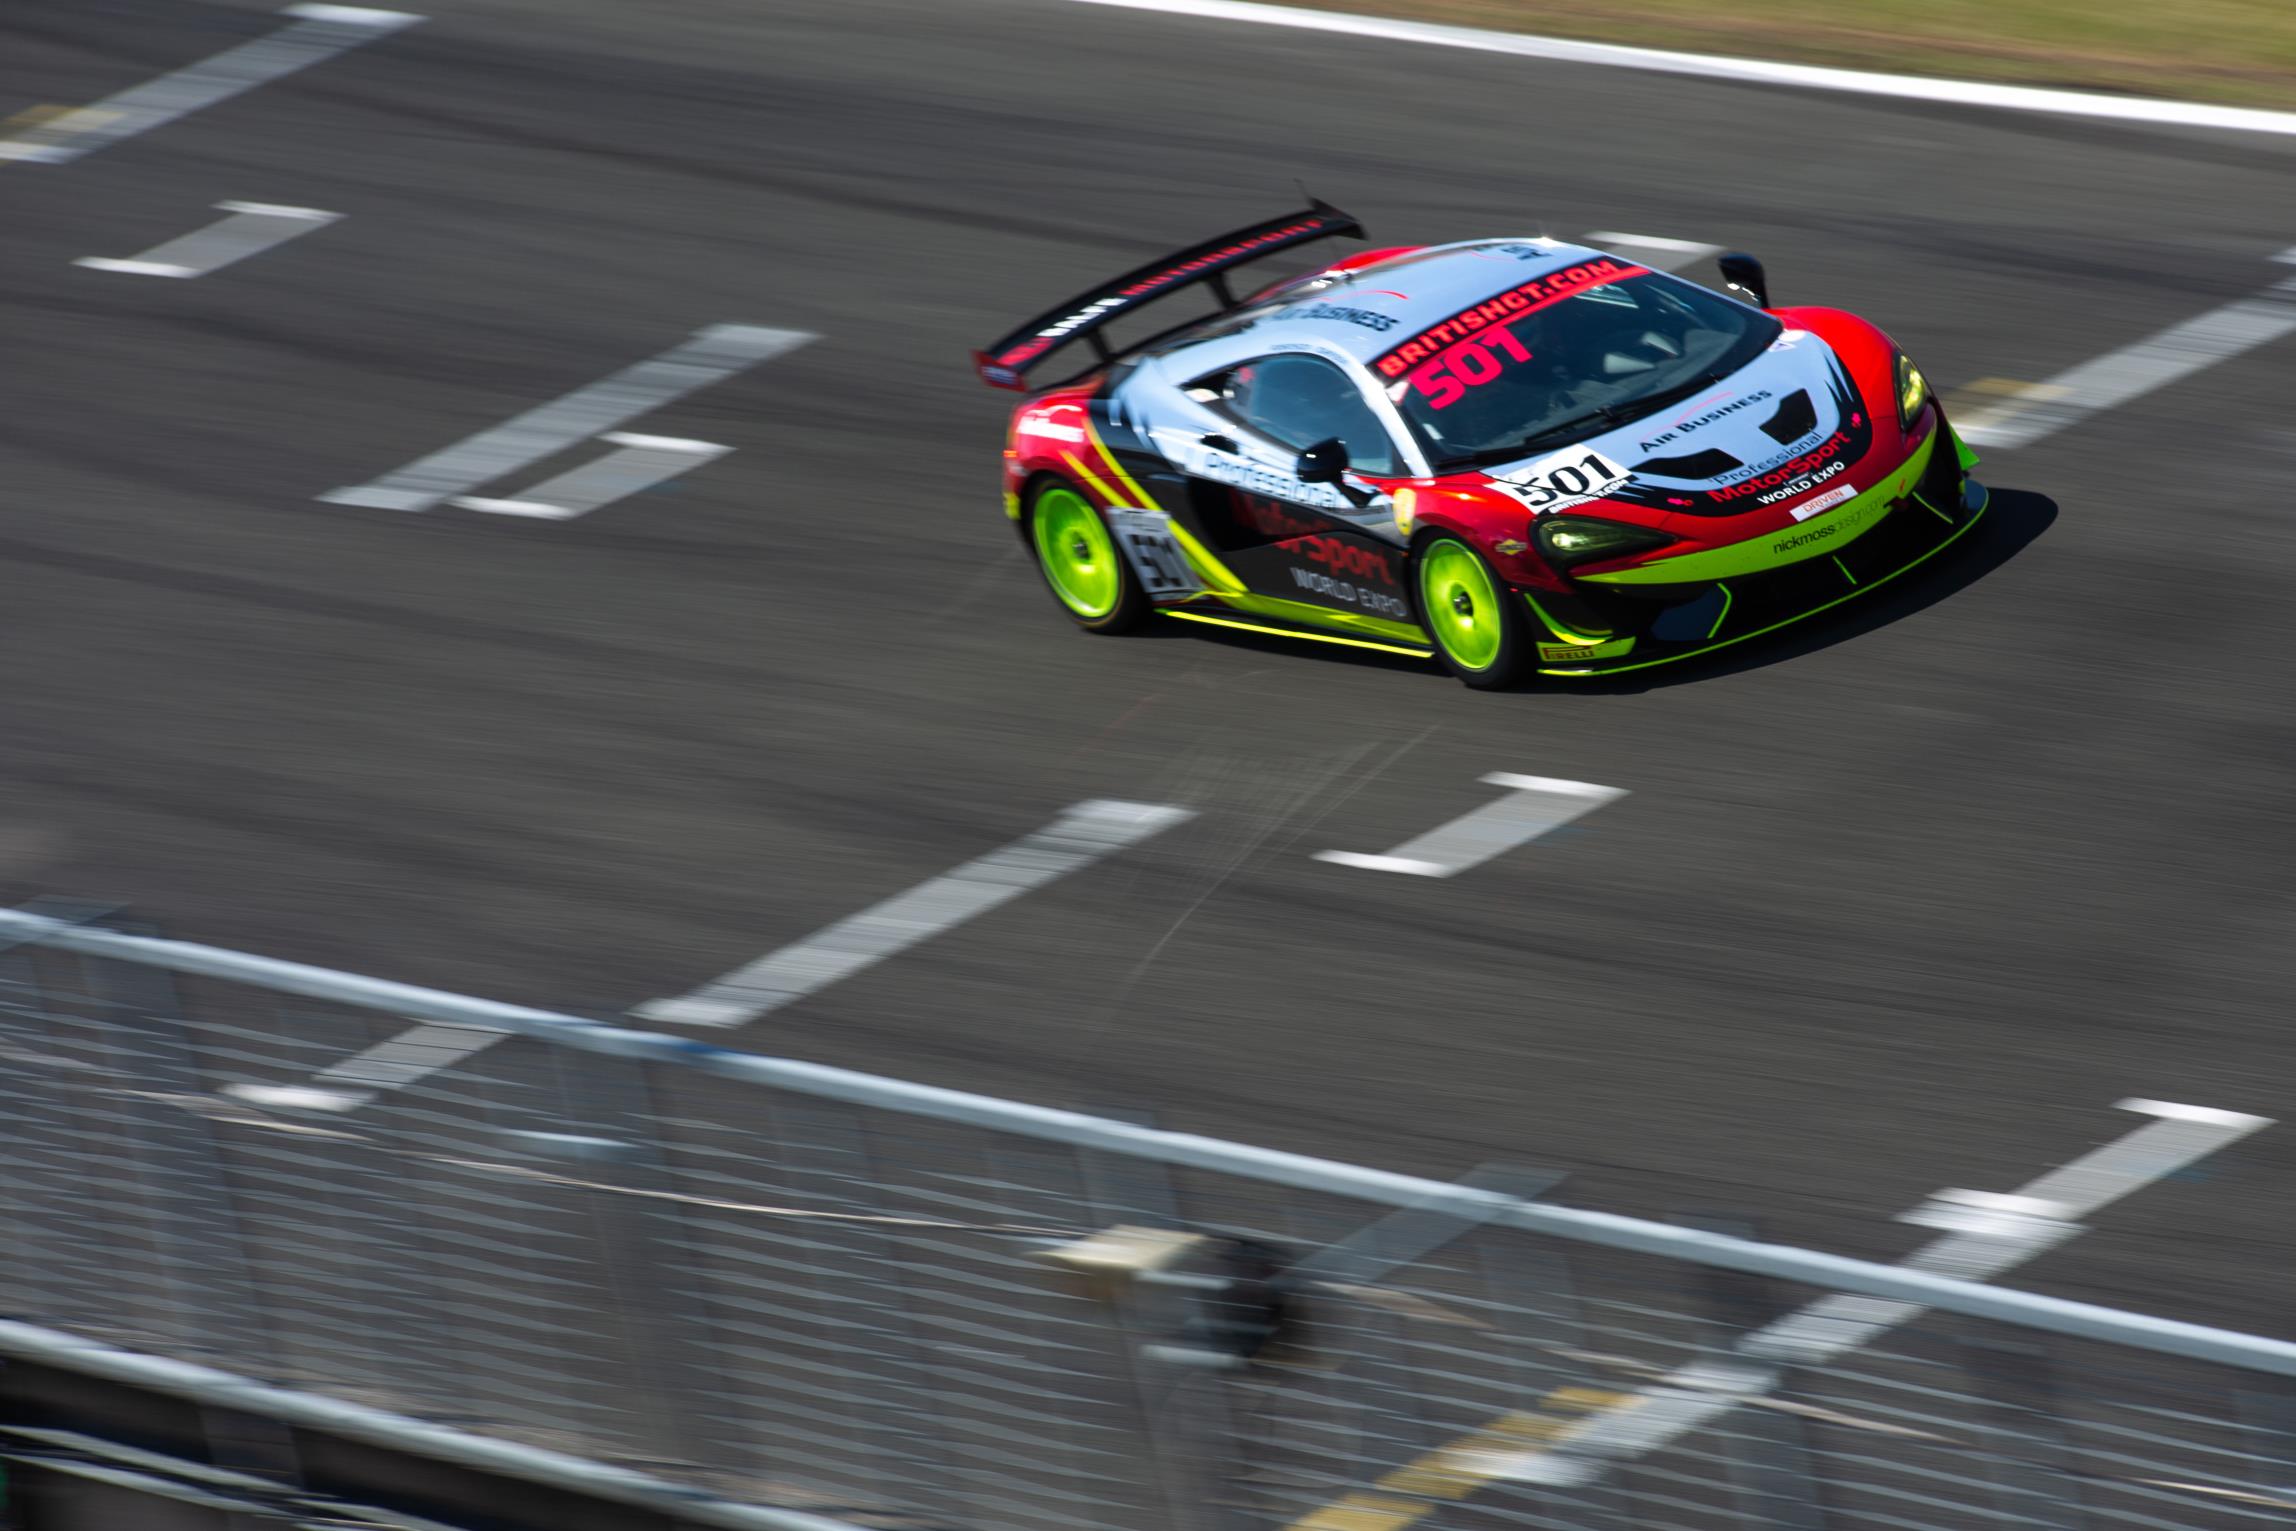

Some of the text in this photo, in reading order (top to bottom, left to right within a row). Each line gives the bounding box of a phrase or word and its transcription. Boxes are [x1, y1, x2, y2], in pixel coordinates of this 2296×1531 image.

[1376, 259, 1619, 378] BRITISHGT.COM
[1407, 325, 1533, 411] 501
[1640, 389, 1773, 453] AIR BUSINESS
[1513, 454, 1616, 507] 501
[1706, 430, 1852, 503] MotorSport
[1711, 430, 1823, 486] Professional
[1756, 478, 1812, 505] WORLD
[1811, 460, 1846, 484] EXPO
[1803, 488, 1844, 512] DRIVEN
[1542, 645, 1595, 660] PIRELLI
